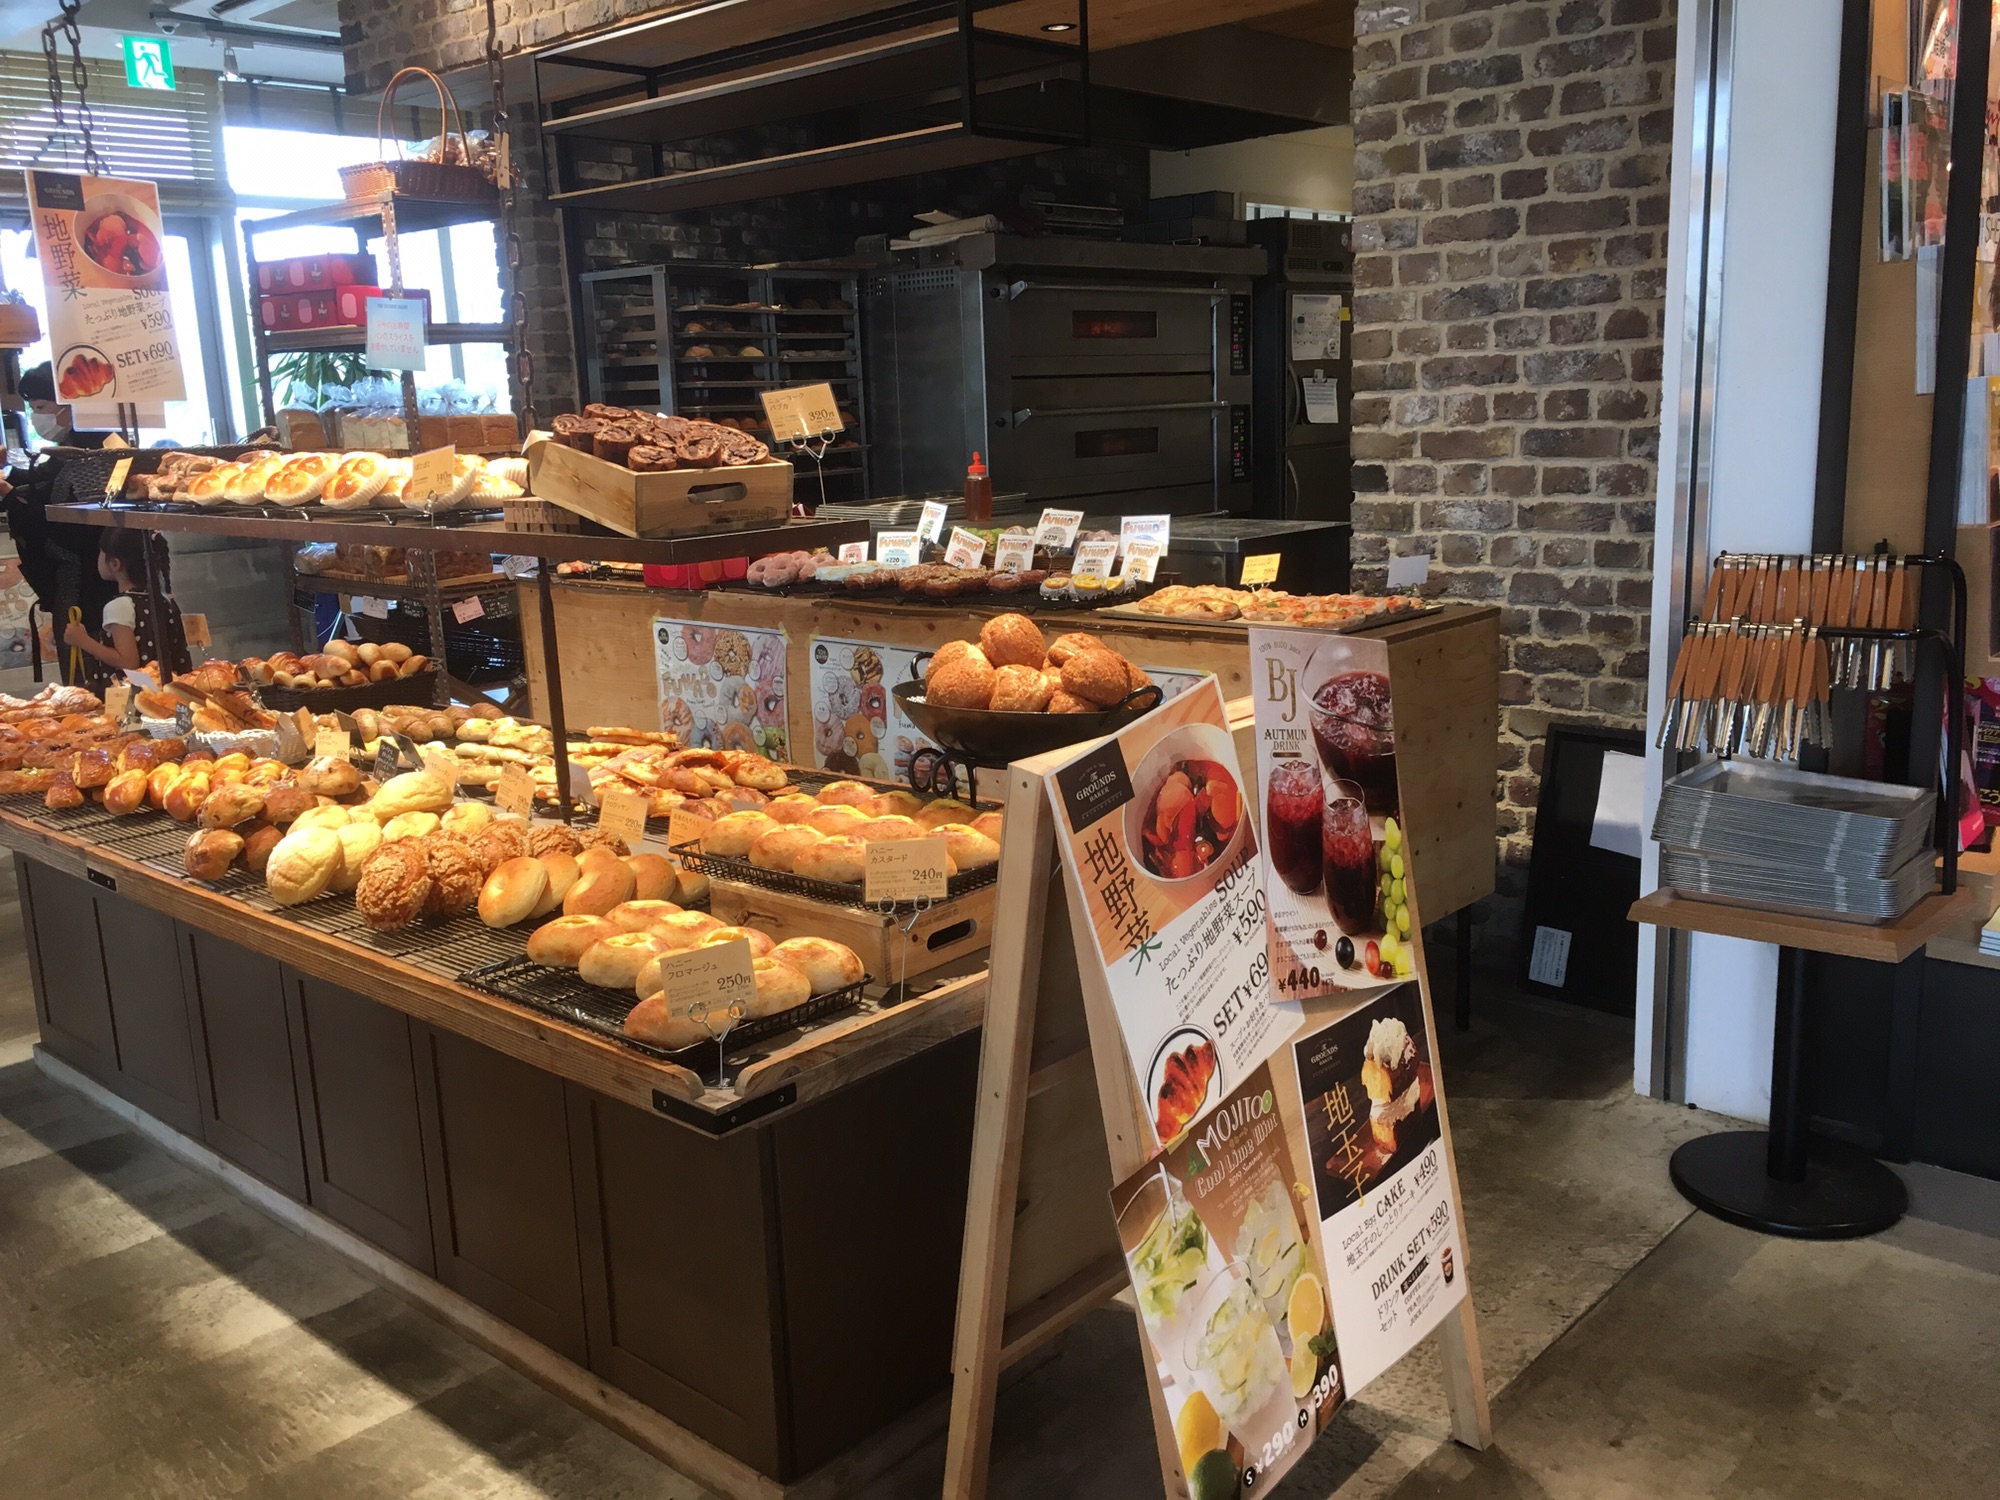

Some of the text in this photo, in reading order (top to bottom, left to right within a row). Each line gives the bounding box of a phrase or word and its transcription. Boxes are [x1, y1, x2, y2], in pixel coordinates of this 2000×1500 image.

[42, 213, 87, 301] 地野菜
[141, 309, 171, 330] ¥590
[116, 340, 173, 368] SET ¥690
[808, 408, 834, 421] 320円
[1265, 657, 1298, 722] BJ
[1264, 728, 1307, 740] AUTMUN
[1273, 741, 1301, 750] DRINK
[1076, 770, 1117, 801] GROUNDS
[1089, 786, 1110, 803] BAKER
[871, 854, 908, 864] カスタード
[912, 868, 943, 881] 240円
[1084, 827, 1163, 977] 地野菜
[1159, 943, 1182, 972] Local
[1180, 899, 1218, 945] Vegetables
[1214, 846, 1250, 903] SOUP
[1232, 888, 1266, 946] ¥590
[1165, 866, 1257, 996] たっぷり地野菜スープ
[665, 959, 693, 970] ハニー
[668, 962, 718, 981] フロマージュ
[1278, 966, 1320, 993] ¥440
[717, 973, 751, 991] 250円
[1213, 985, 1245, 1038] SET
[1241, 943, 1270, 998] ¥69
[1196, 1094, 1265, 1168] MOJITO
[1322, 1081, 1370, 1207] 地玉子
[1341, 1225, 1364, 1250] Local
[1376, 1177, 1406, 1218] CAKE
[1413, 1149, 1437, 1188] ¥490
[1371, 1252, 1408, 1301] DRINK
[1406, 1227, 1426, 1263] SET
[1425, 1200, 1448, 1239] ¥590
[1380, 1309, 1398, 1333] セット
[1300, 1364, 1339, 1427] M ¥390
[1246, 1420, 1295, 1485] S ¥290
